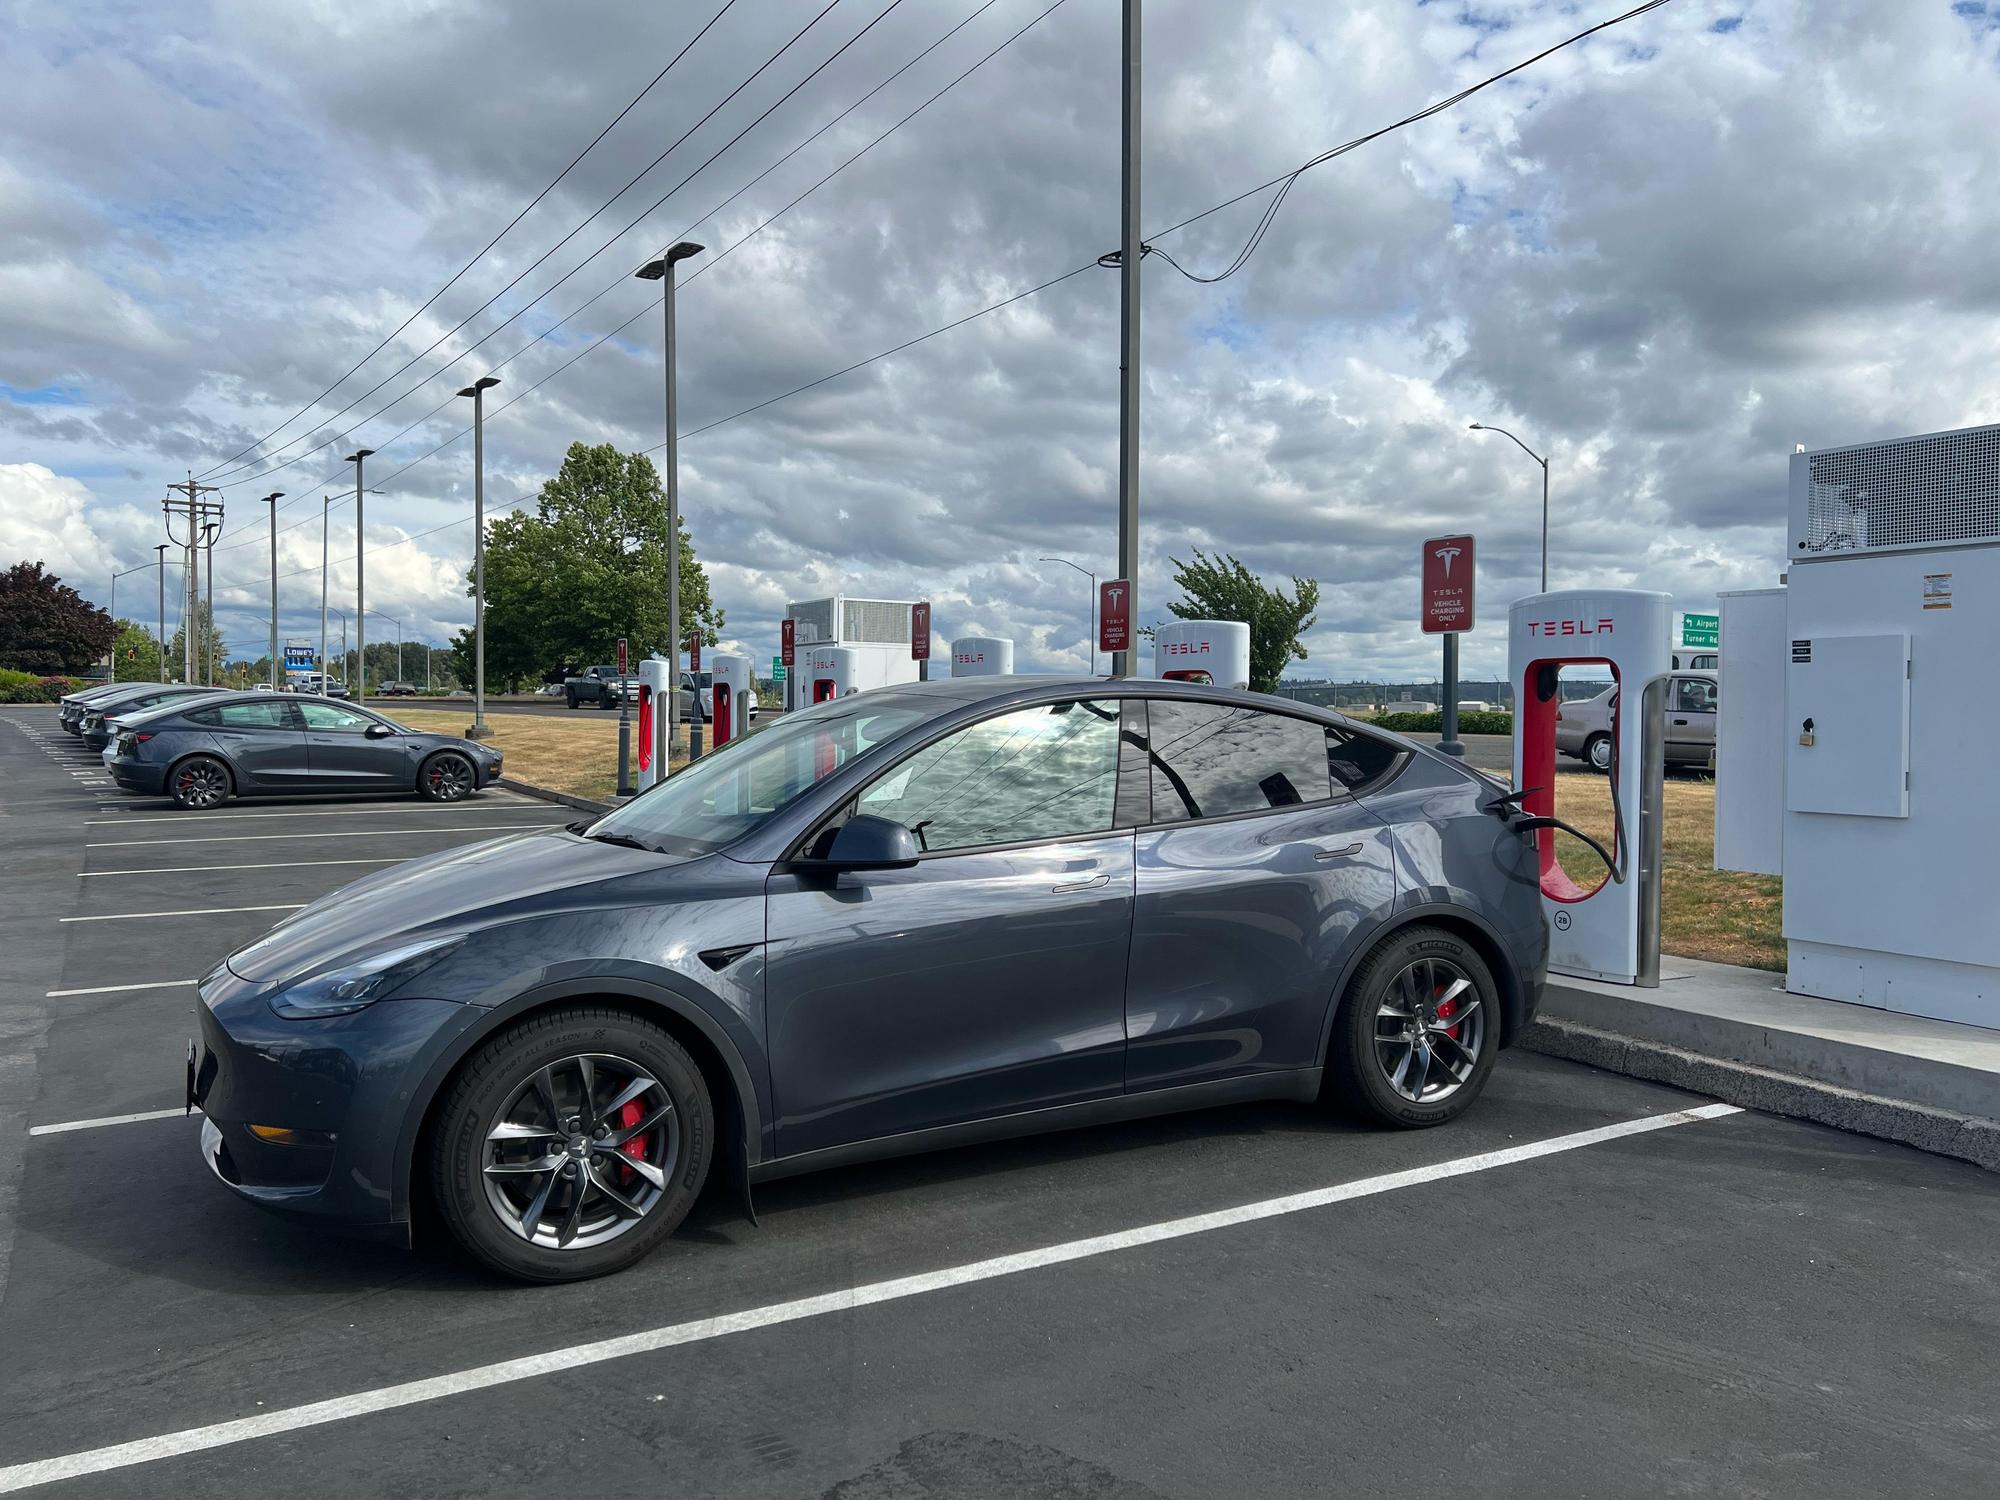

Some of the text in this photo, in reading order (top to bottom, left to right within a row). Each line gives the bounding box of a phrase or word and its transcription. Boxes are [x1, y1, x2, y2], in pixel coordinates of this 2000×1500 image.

[1432, 588, 1463, 596] TESLA
[1430, 607, 1464, 615] CHARGING
[1528, 618, 1613, 637] TESLA
[1696, 619, 1718, 629] Airport
[1686, 634, 1705, 643] Turner
[1162, 642, 1210, 655] TESLA
[954, 653, 984, 663] TESLA
[1558, 916, 1568, 925] 2B
[1421, 940, 1462, 952] MICHELIN
